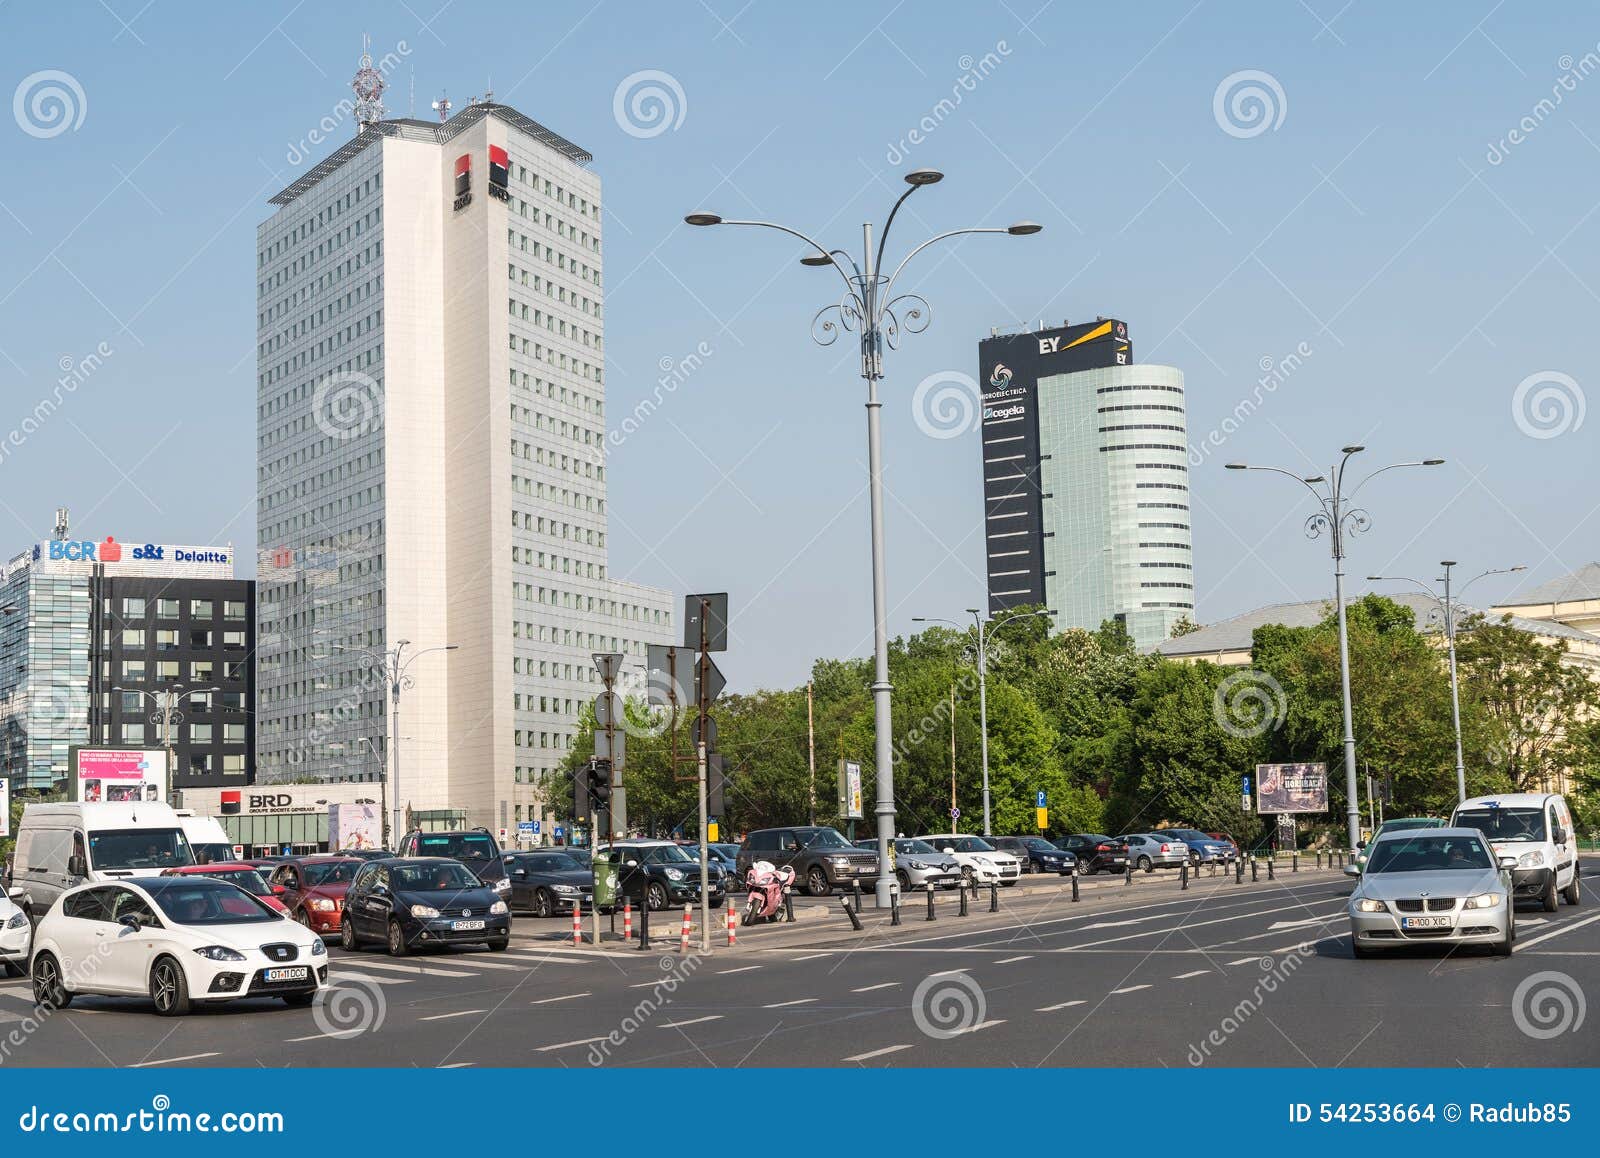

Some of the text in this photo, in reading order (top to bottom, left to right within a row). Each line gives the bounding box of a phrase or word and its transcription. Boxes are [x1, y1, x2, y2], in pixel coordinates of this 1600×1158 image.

[1039, 336, 1061, 354] EY
[1116, 353, 1126, 364] EY
[992, 405, 1025, 418] cegeka
[49, 540, 96, 561] BCR
[132, 543, 164, 560] s&t
[249, 794, 292, 807] BRD
